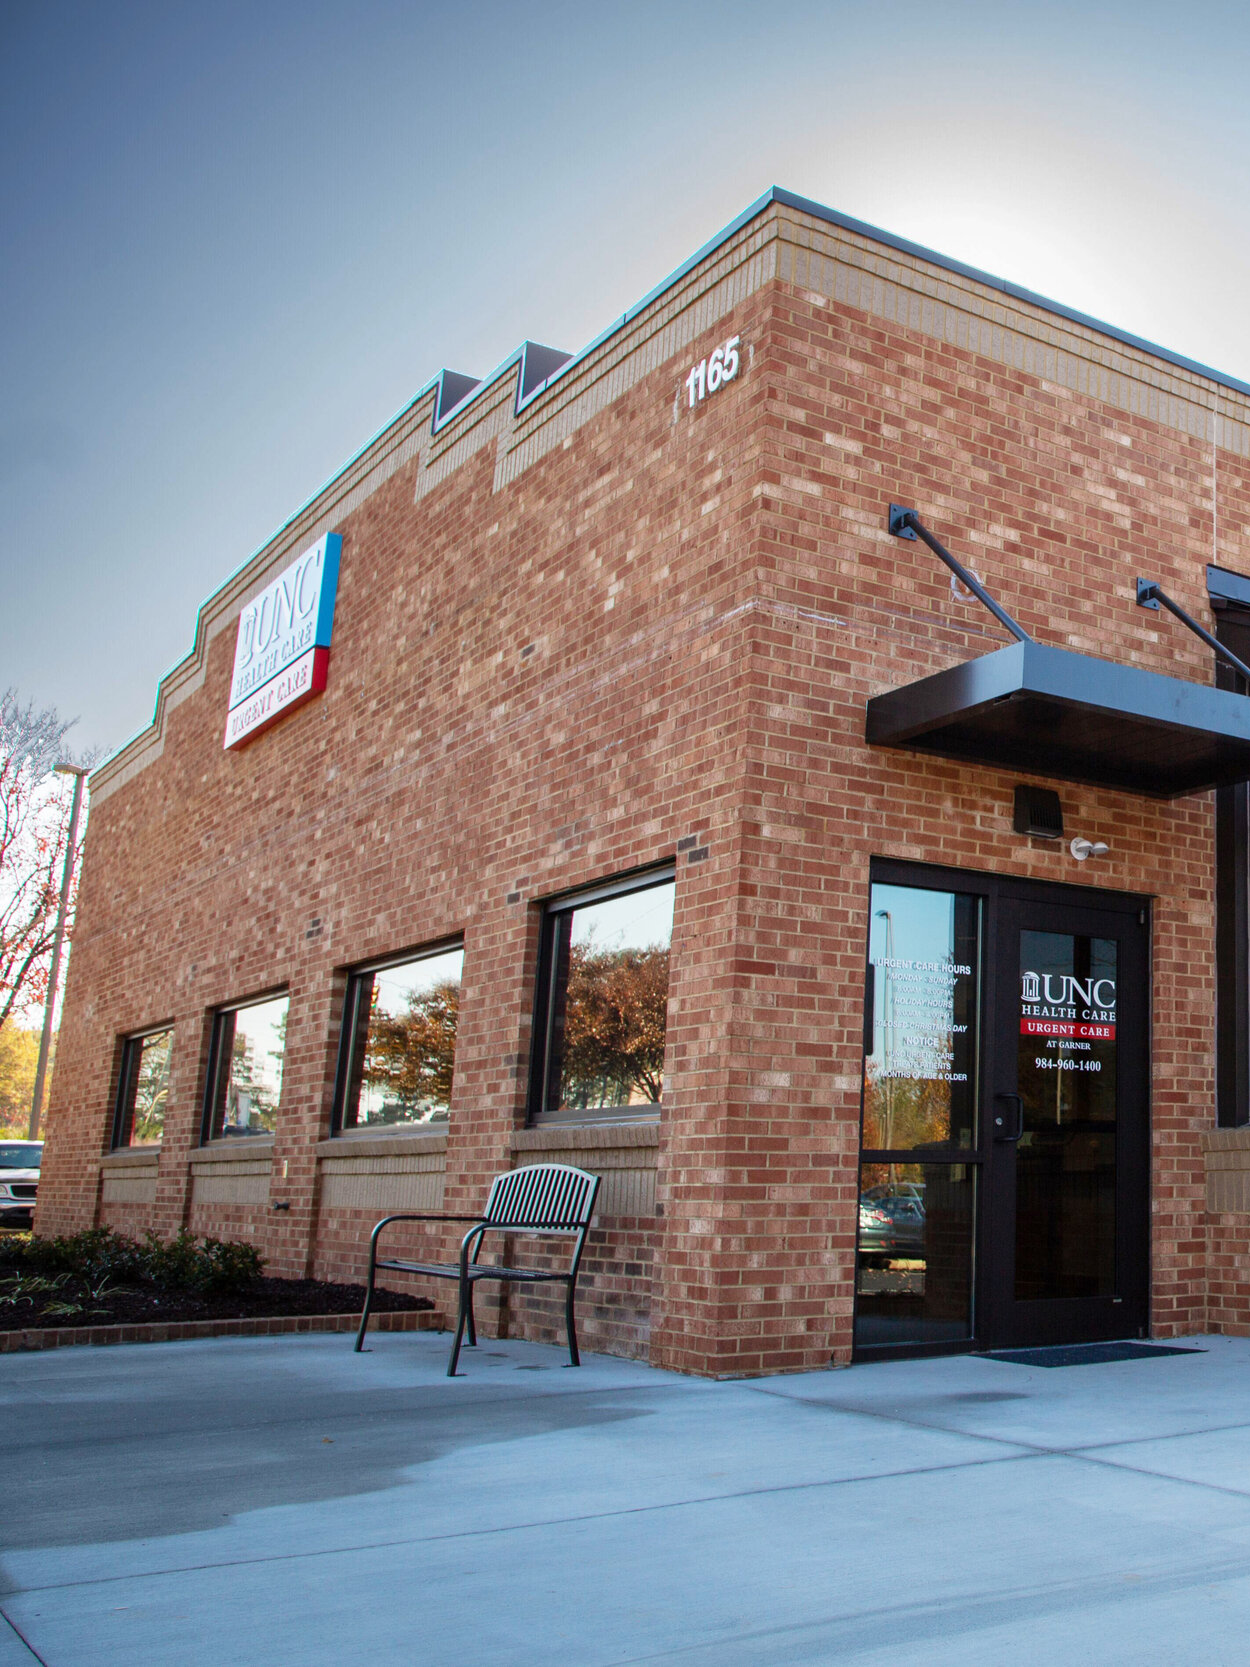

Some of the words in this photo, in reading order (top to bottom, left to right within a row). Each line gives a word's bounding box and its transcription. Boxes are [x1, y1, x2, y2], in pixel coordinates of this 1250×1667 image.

[686, 334, 740, 408] 1165
[254, 550, 321, 655] UNC
[234, 651, 279, 700] HEALTH
[280, 622, 313, 662] CARE
[231, 688, 274, 736] URGENT
[276, 664, 308, 703] CARE
[877, 957, 913, 969] URGENT
[916, 961, 939, 971] CARE
[942, 965, 971, 975] HOURS
[890, 973, 922, 982] MONDAY
[928, 976, 958, 986] SUNDAY
[1041, 973, 1117, 1009] UNC
[894, 998, 925, 1006] HOLIDAY
[927, 1000, 953, 1008] HOURS
[1021, 1005, 1077, 1019] HEALTH
[1082, 1009, 1117, 1022] CARE
[878, 1019, 907, 1029] CLOSED
[909, 1022, 951, 1032] CHRISTMAS
[1027, 1022, 1075, 1035] URGENT
[1080, 1027, 1110, 1037] CARE
[906, 1036, 940, 1047] NOTICE
[1046, 1040, 1057, 1048] AT
[1058, 1041, 1091, 1050] GARNER
[935, 1052, 955, 1060] CARE
[920, 1062, 951, 1070] PATIENTS
[1035, 1057, 1101, 1072] 984-960-1400
[880, 1070, 911, 1079] MONTHS
[911, 1072, 921, 1080] OF
[923, 1072, 937, 1080] AGE
[944, 1072, 968, 1081] OLDER
